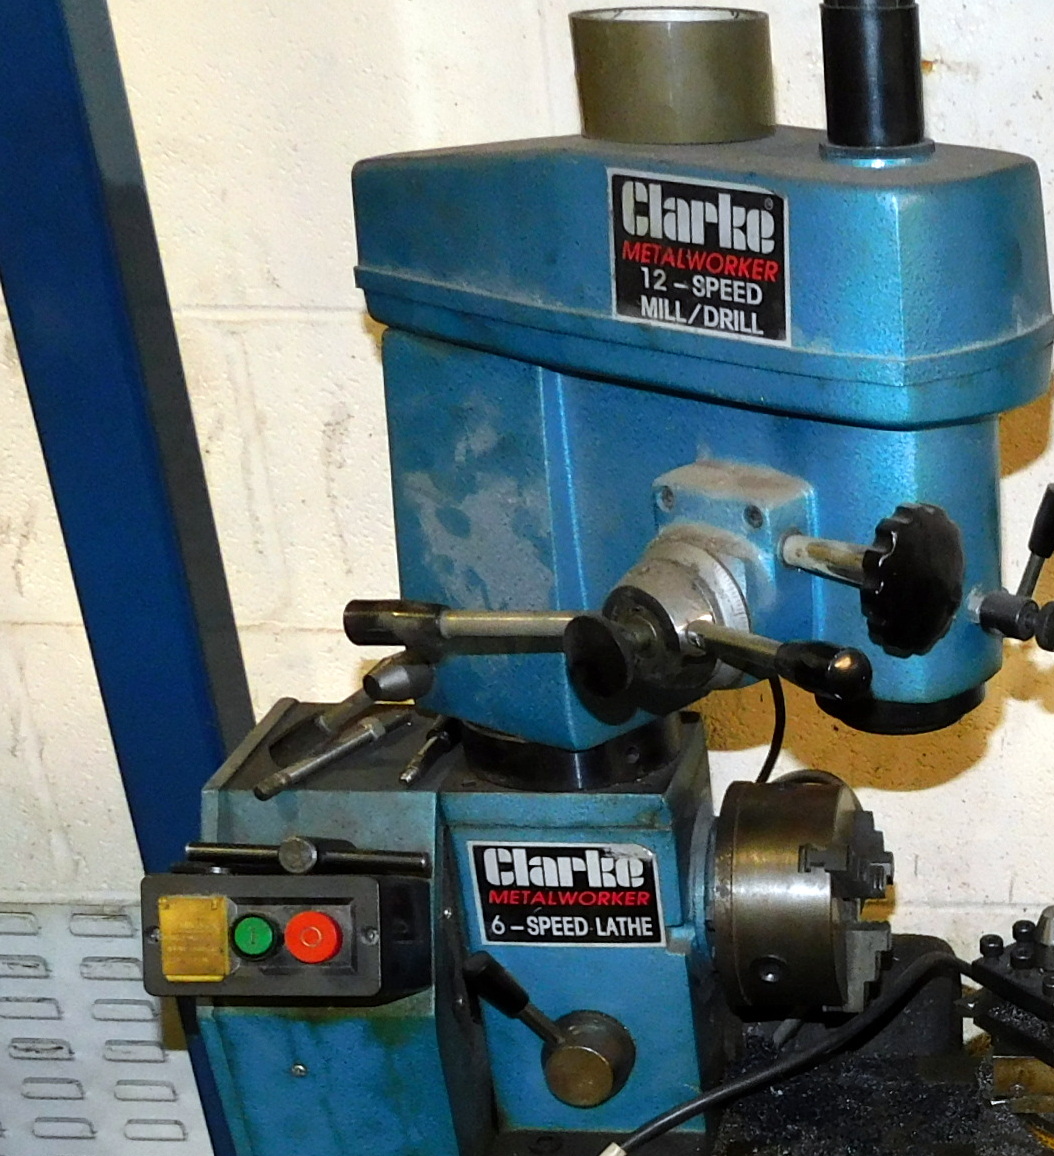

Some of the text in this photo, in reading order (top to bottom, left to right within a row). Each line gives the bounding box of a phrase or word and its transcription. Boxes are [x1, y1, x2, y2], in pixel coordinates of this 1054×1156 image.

[621, 180, 775, 255] Clarke
[621, 240, 779, 282] METALWORKER
[640, 294, 764, 335] MILL/DRILL
[483, 848, 645, 888] Clarke
[488, 890, 650, 906] METALWORKER
[595, 916, 653, 937] LATHE
